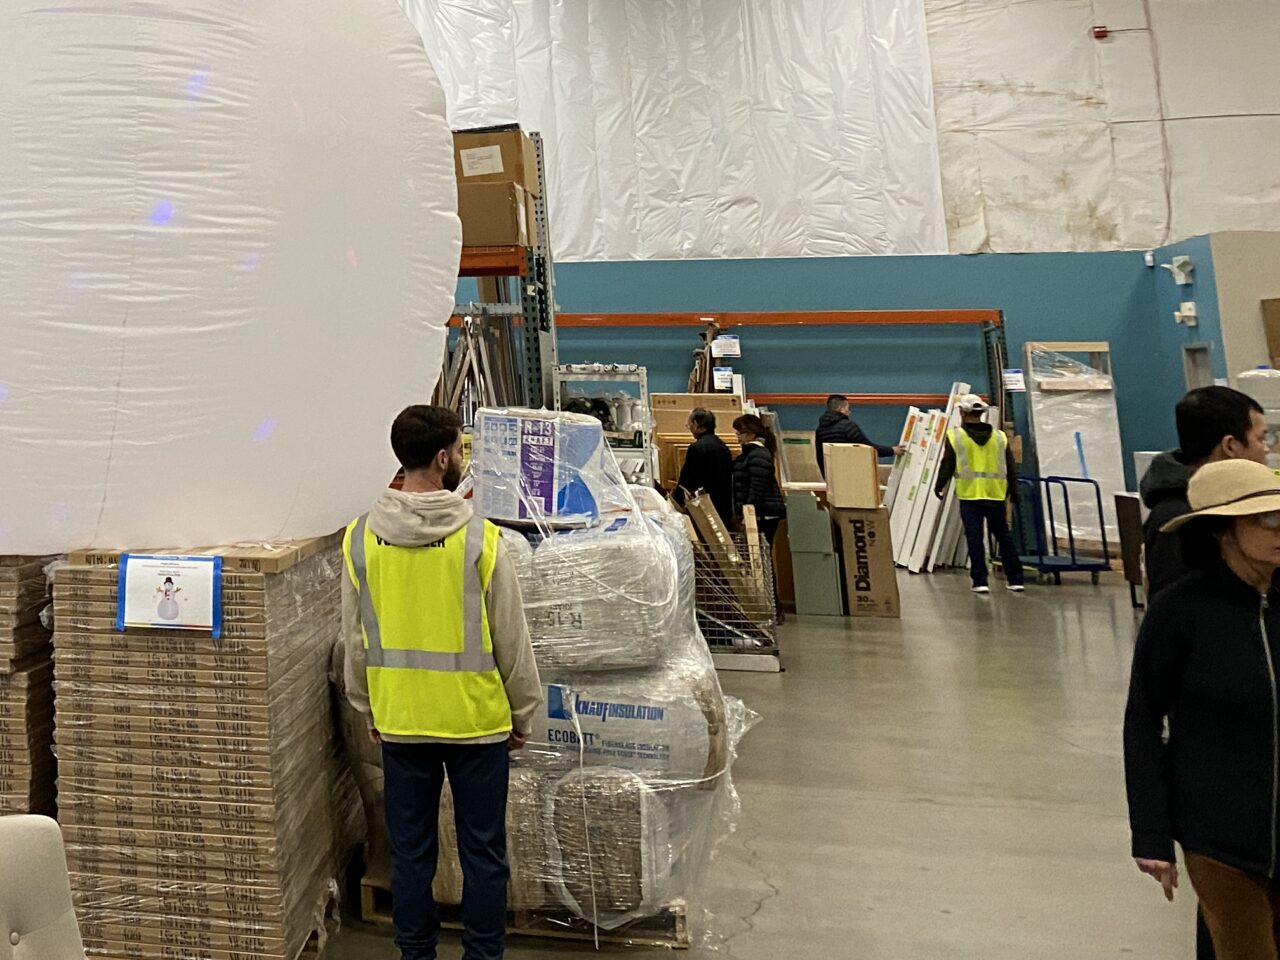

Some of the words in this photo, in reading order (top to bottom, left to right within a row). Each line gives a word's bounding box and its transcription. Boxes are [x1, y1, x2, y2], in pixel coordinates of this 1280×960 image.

[524, 420, 552, 435] R-13
[848, 519, 871, 592] Diamond
[548, 728, 594, 746] ECOBTT
